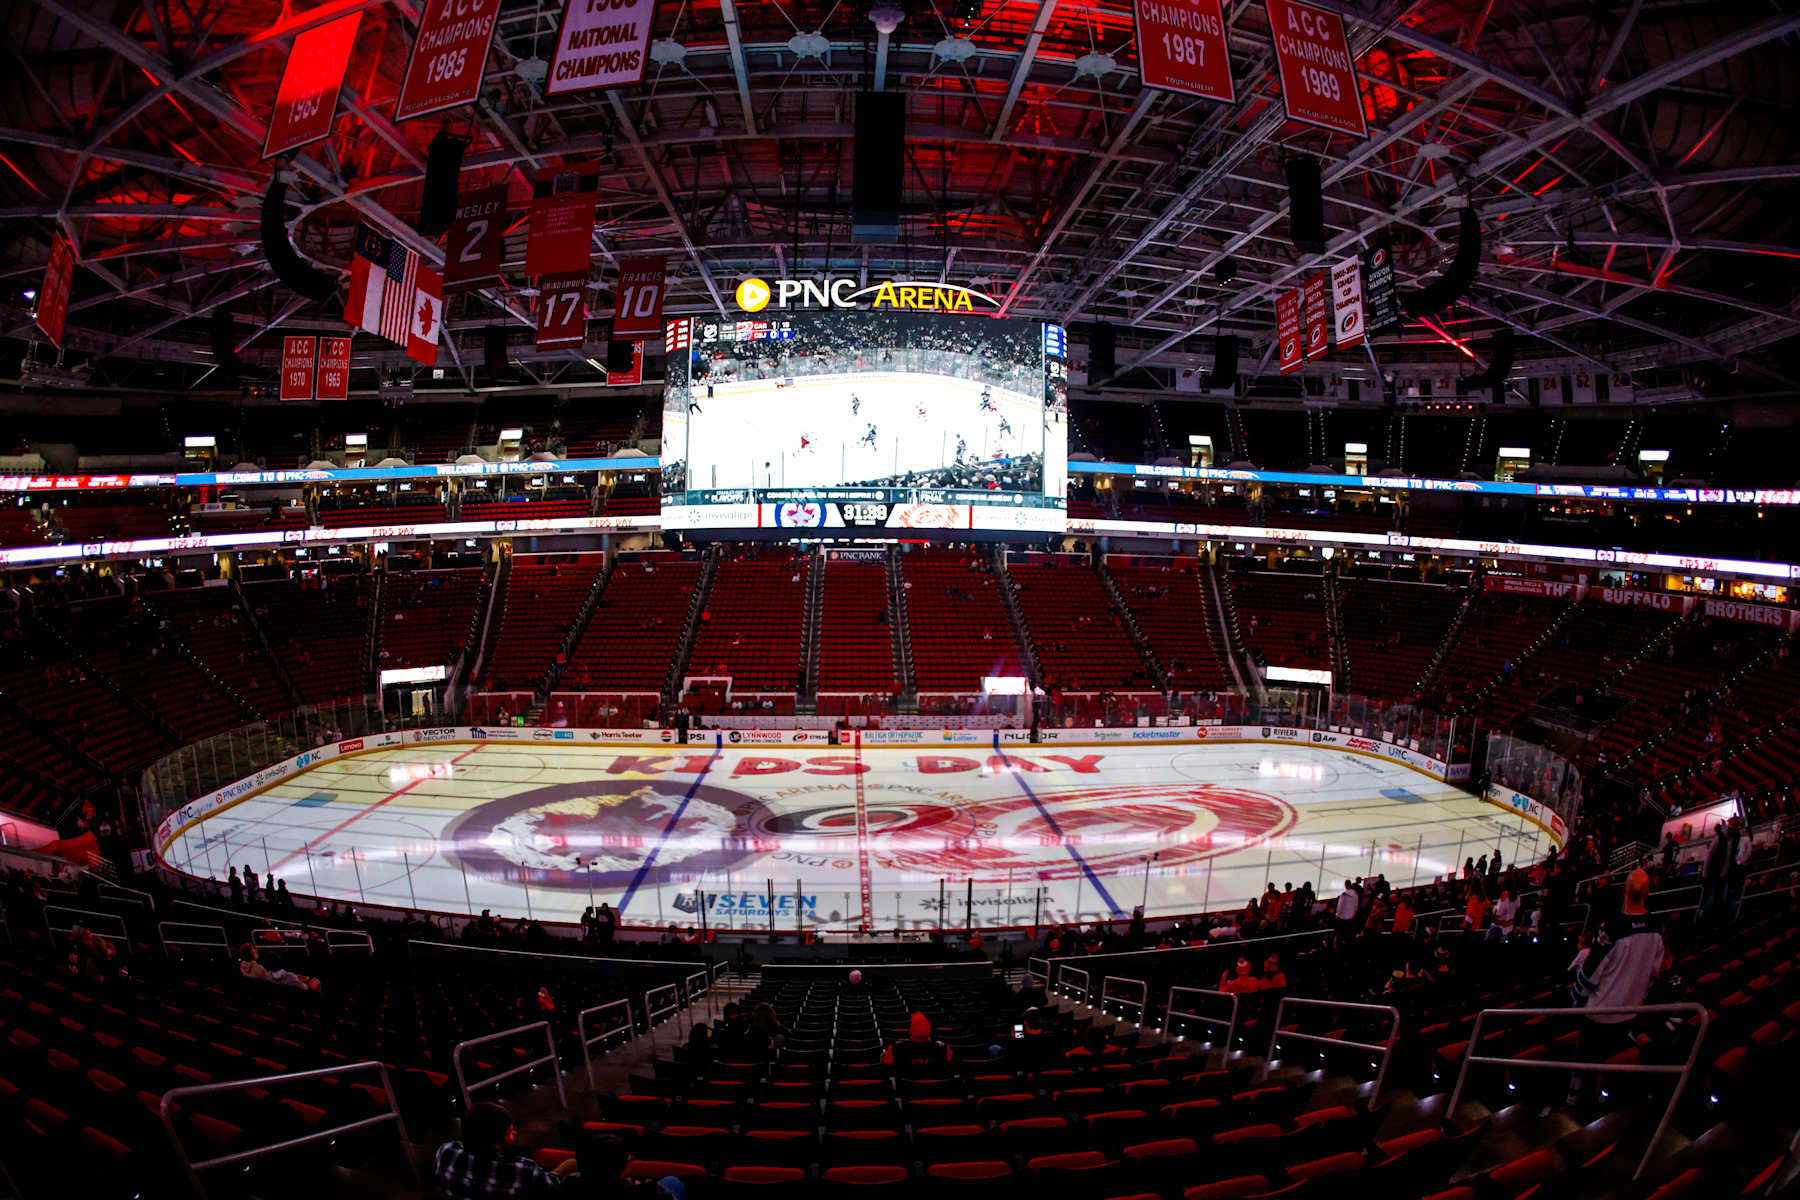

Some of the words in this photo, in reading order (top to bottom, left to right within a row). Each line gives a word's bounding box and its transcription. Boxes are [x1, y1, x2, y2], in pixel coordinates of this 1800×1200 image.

[1142, 1, 1219, 37] CHAMPIONS
[1287, 6, 1330, 41] ACC
[419, 15, 492, 53] CHAMPIONS
[568, 22, 639, 50] NATIONAL
[1162, 31, 1205, 66] 1987
[1279, 33, 1349, 73] CHAMPIONS
[426, 48, 468, 84] 1985
[555, 50, 641, 81] CHAMPIONS
[1301, 66, 1340, 101] 1989
[456, 201, 500, 219] WESLEY
[459, 219, 489, 264] 2
[622, 271, 663, 282] FRANCIS
[620, 285, 659, 319] 10
[775, 279, 857, 309] PNC
[872, 280, 974, 311] ARENA
[543, 291, 581, 328] 17
[290, 339, 309, 354] ACC
[289, 371, 306, 387] 1970
[325, 372, 341, 388] 1965
[437, 463, 482, 475] WELCOME
[484, 463, 498, 473] TO
[1135, 464, 1182, 476] WELCOME
[1183, 466, 1197, 477] TO
[215, 472, 261, 484] WELCOME
[262, 472, 275, 481] TO
[1361, 477, 1409, 489] WELCOME
[1410, 478, 1423, 488] TO
[588, 518, 610, 528] KIDS
[613, 518, 633, 527] DAY
[1078, 521, 1095, 531] DAY
[372, 528, 394, 537] KIDS
[398, 527, 414, 537] DAY
[1265, 530, 1287, 538] KIDS
[1290, 531, 1309, 540] DAY
[192, 537, 209, 548] DAY
[1479, 543, 1501, 552] KIDS
[1504, 544, 1521, 554] DAY
[840, 552, 860, 560] PNC
[861, 552, 882, 560] BANK
[1679, 558, 1700, 568] KIDS
[1702, 560, 1720, 571] DAY
[1603, 588, 1671, 609] BUFFALO
[1704, 601, 1783, 626] BROTHERS
[422, 729, 455, 737] VECTOR
[601, 731, 622, 739] Harris
[1133, 731, 1180, 739] ticketmaster
[1273, 728, 1298, 737] RIVIERA
[340, 742, 362, 752] Lenovo
[311, 751, 321, 761] NC
[606, 755, 870, 779] KIDS
[916, 754, 1104, 778] DAY
[222, 787, 236, 801] PNC
[236, 781, 254, 794] BANK
[1529, 803, 1539, 815] NC
[719, 893, 817, 909] SEVEN
